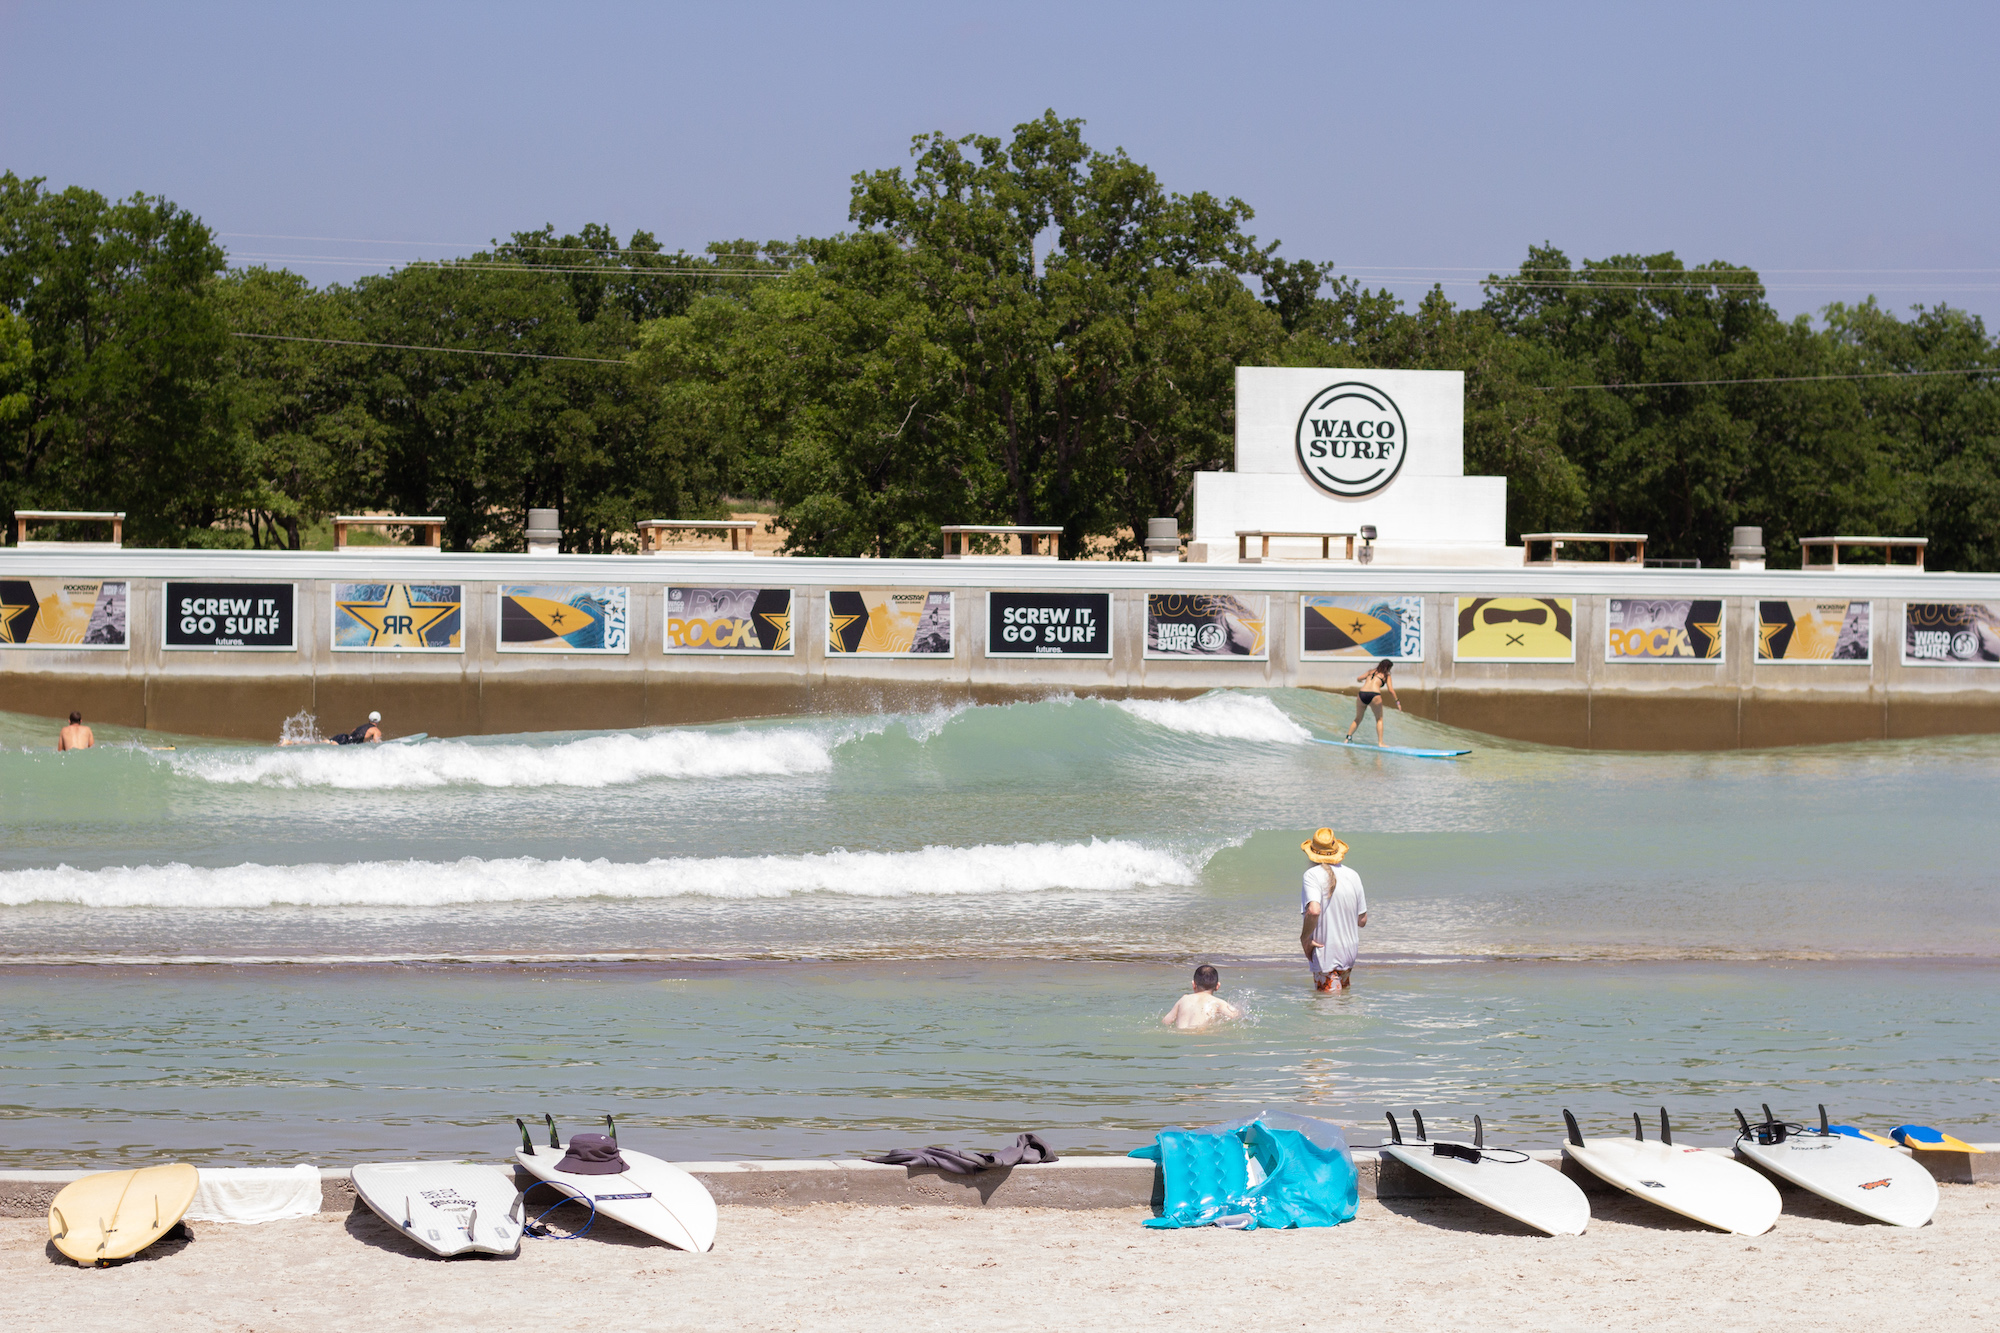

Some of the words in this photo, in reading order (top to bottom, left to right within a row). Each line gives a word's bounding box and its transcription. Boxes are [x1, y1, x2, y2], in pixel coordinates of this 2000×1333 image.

[1309, 418, 1396, 440] WACO
[1309, 439, 1396, 461] SURF
[63, 584, 99, 592] ROCKSTAR
[180, 597, 252, 616] SCREW
[257, 598, 280, 618] IT,
[180, 616, 217, 635] GO
[224, 616, 280, 635] SURF
[1003, 607, 1070, 625] SCREW
[1075, 608, 1097, 627] IT,
[1002, 625, 1037, 643] GO
[1044, 626, 1097, 643] SURF
[1157, 623, 1197, 637] WACO
[1914, 630, 1951, 645] WACO
[1157, 637, 1197, 651] SURF
[1914, 644, 1951, 658] SURF
